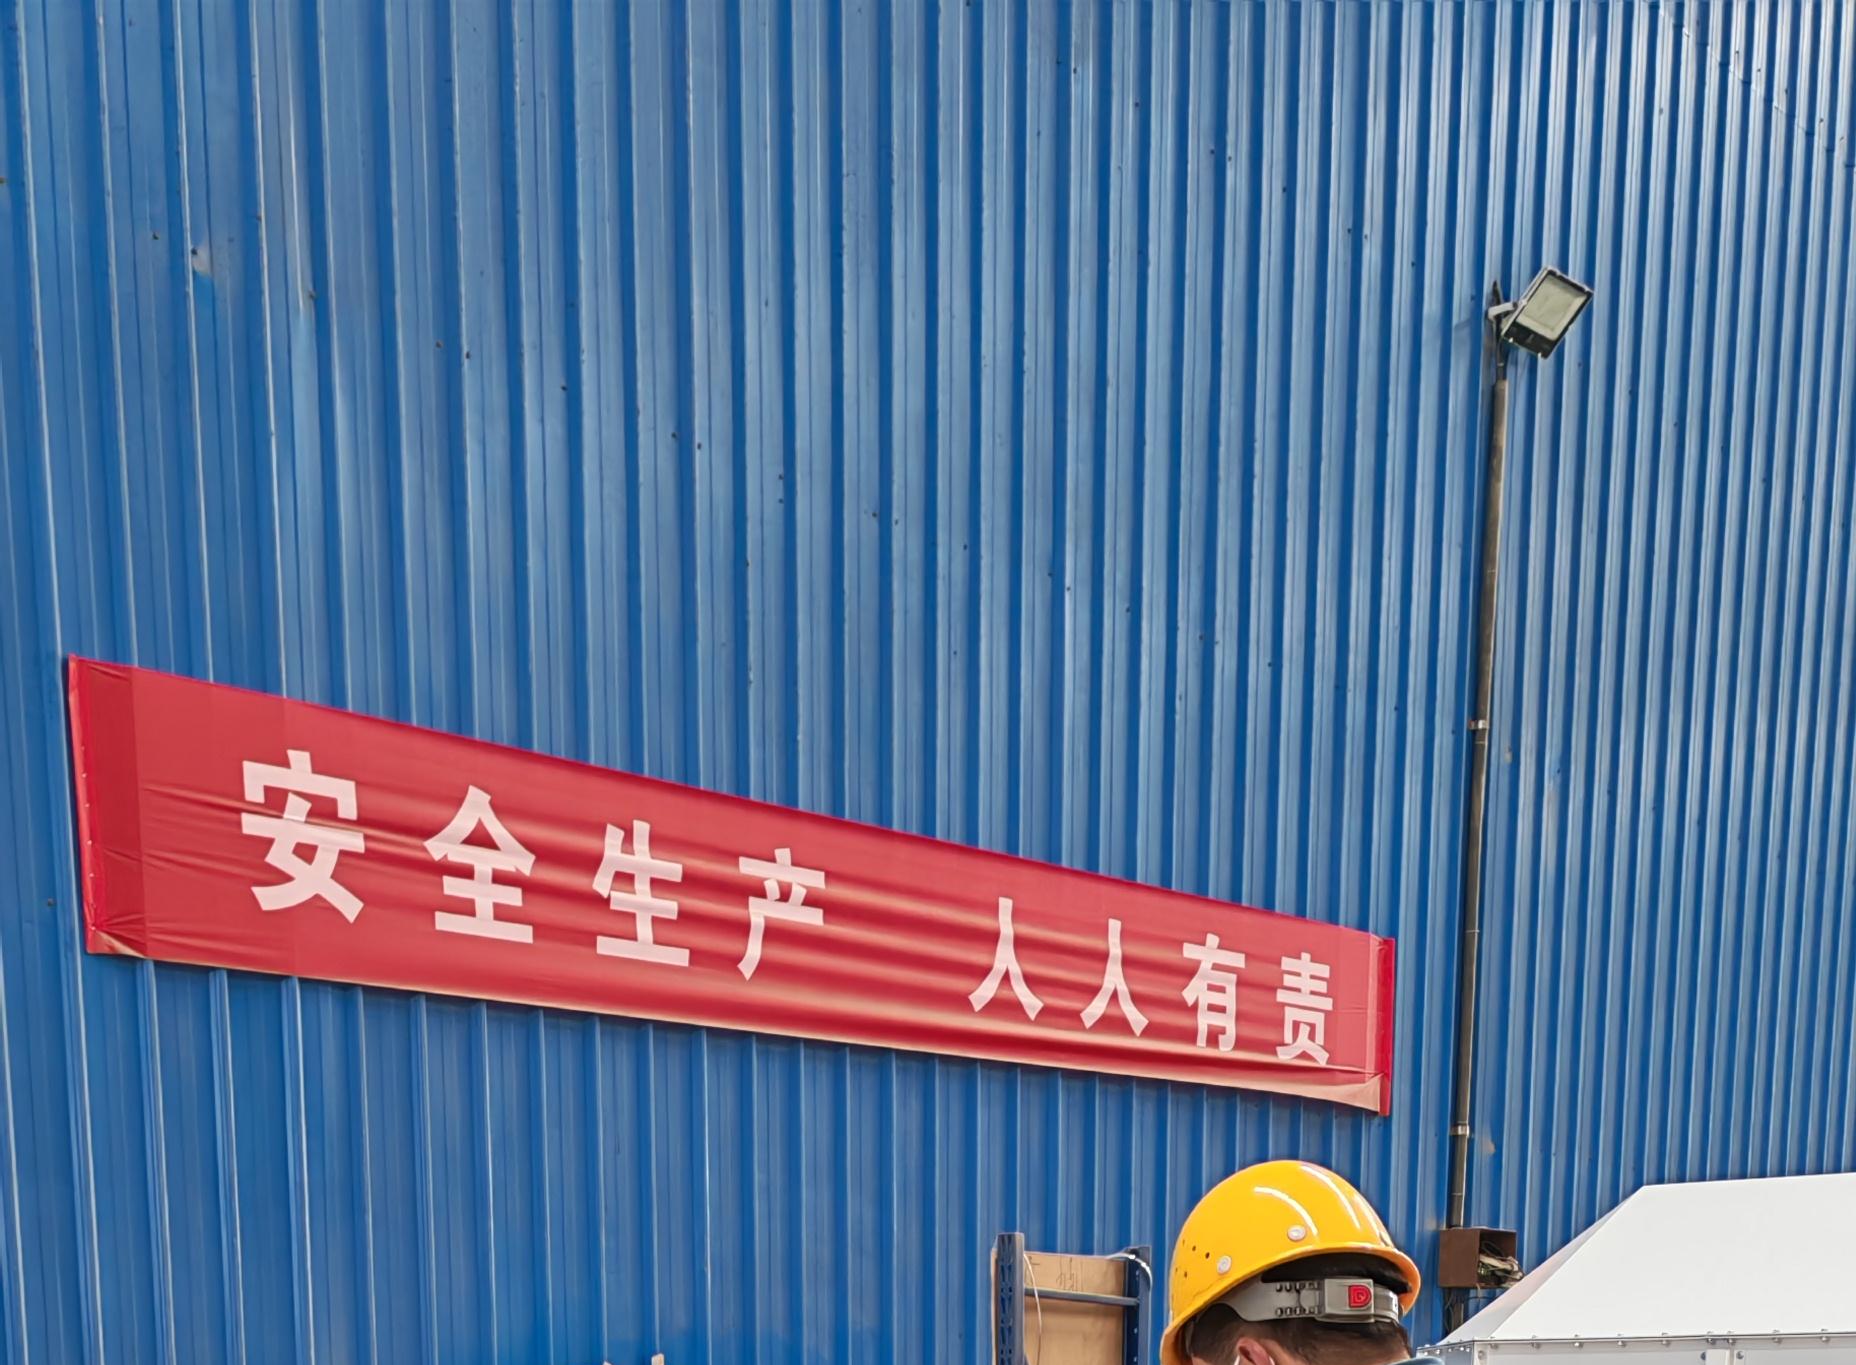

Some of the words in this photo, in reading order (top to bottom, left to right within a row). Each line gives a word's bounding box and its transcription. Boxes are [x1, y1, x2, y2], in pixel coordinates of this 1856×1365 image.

[241, 749, 826, 980] 安全生产
[968, 896, 1333, 1065] 人人有责
